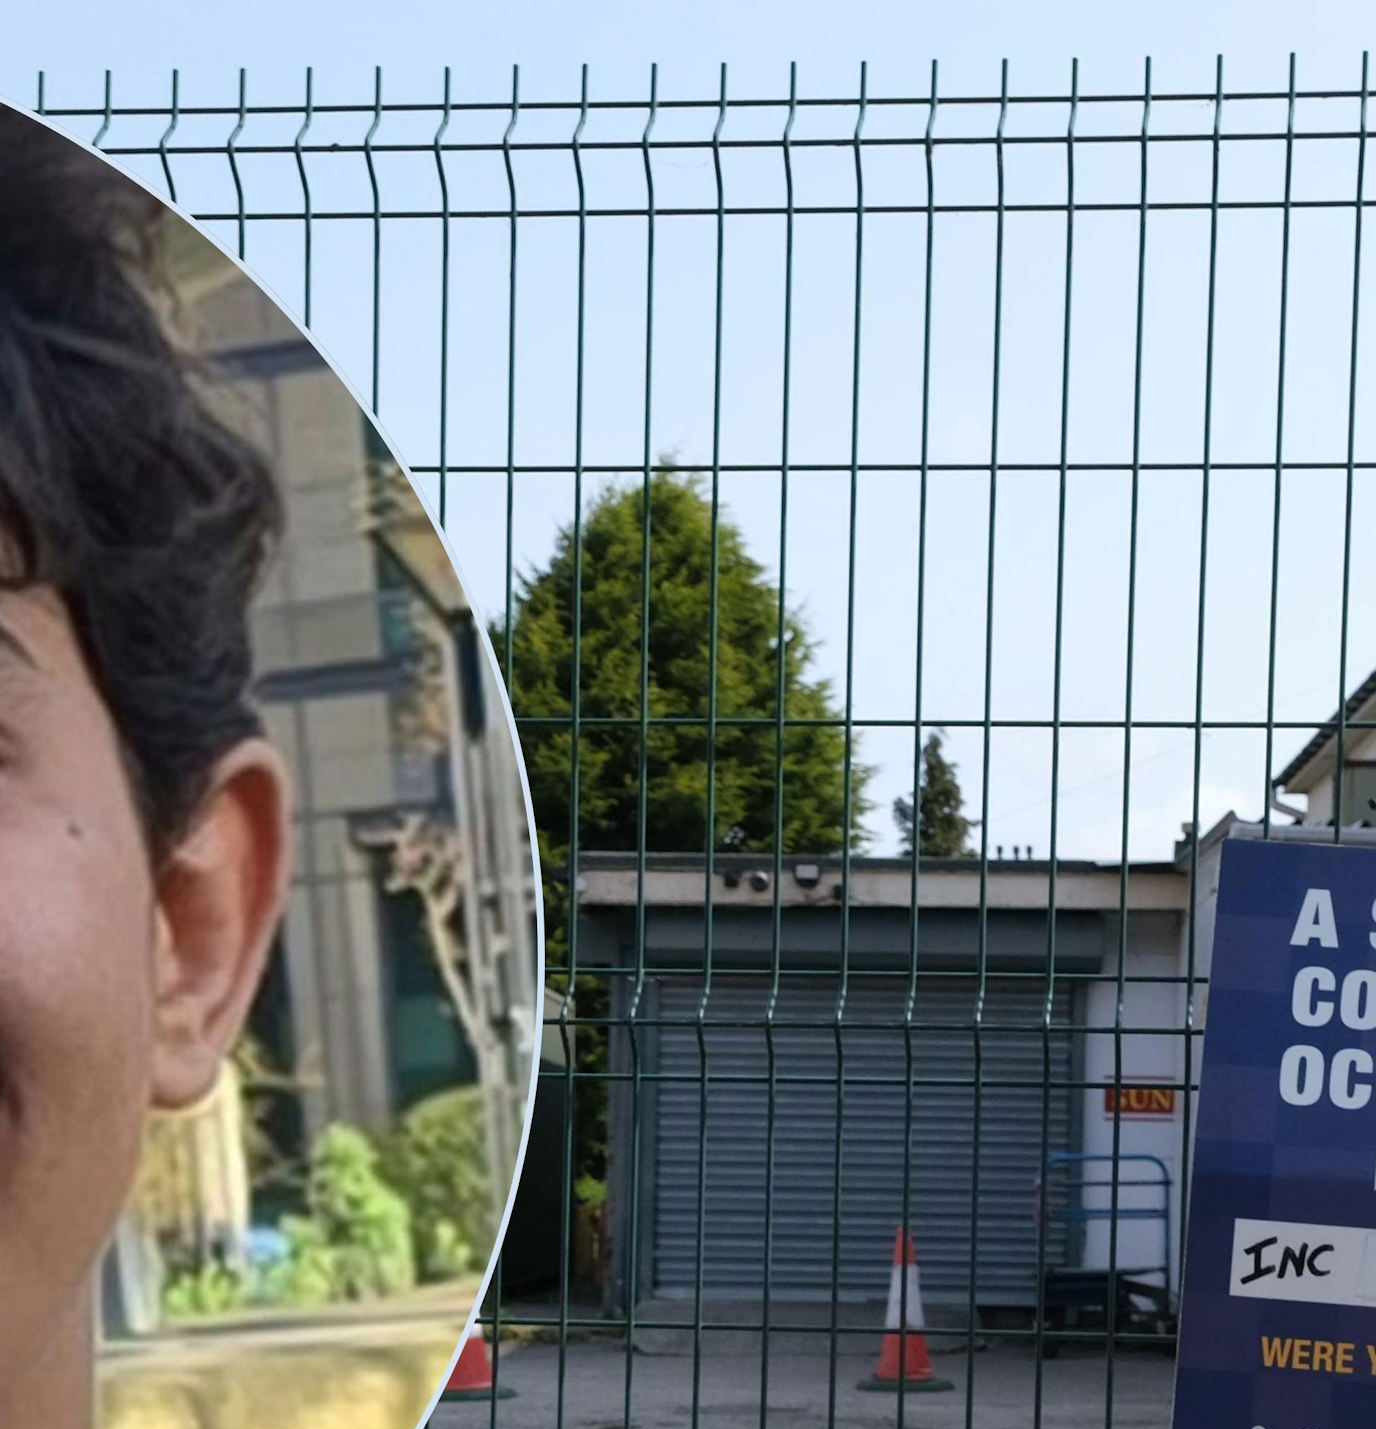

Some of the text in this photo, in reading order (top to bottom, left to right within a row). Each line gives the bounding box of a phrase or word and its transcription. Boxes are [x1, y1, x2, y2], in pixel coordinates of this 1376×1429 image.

[1290, 888, 1338, 948] A
[1240, 1236, 1335, 1285] INC
[1260, 1335, 1355, 1374] WERE
